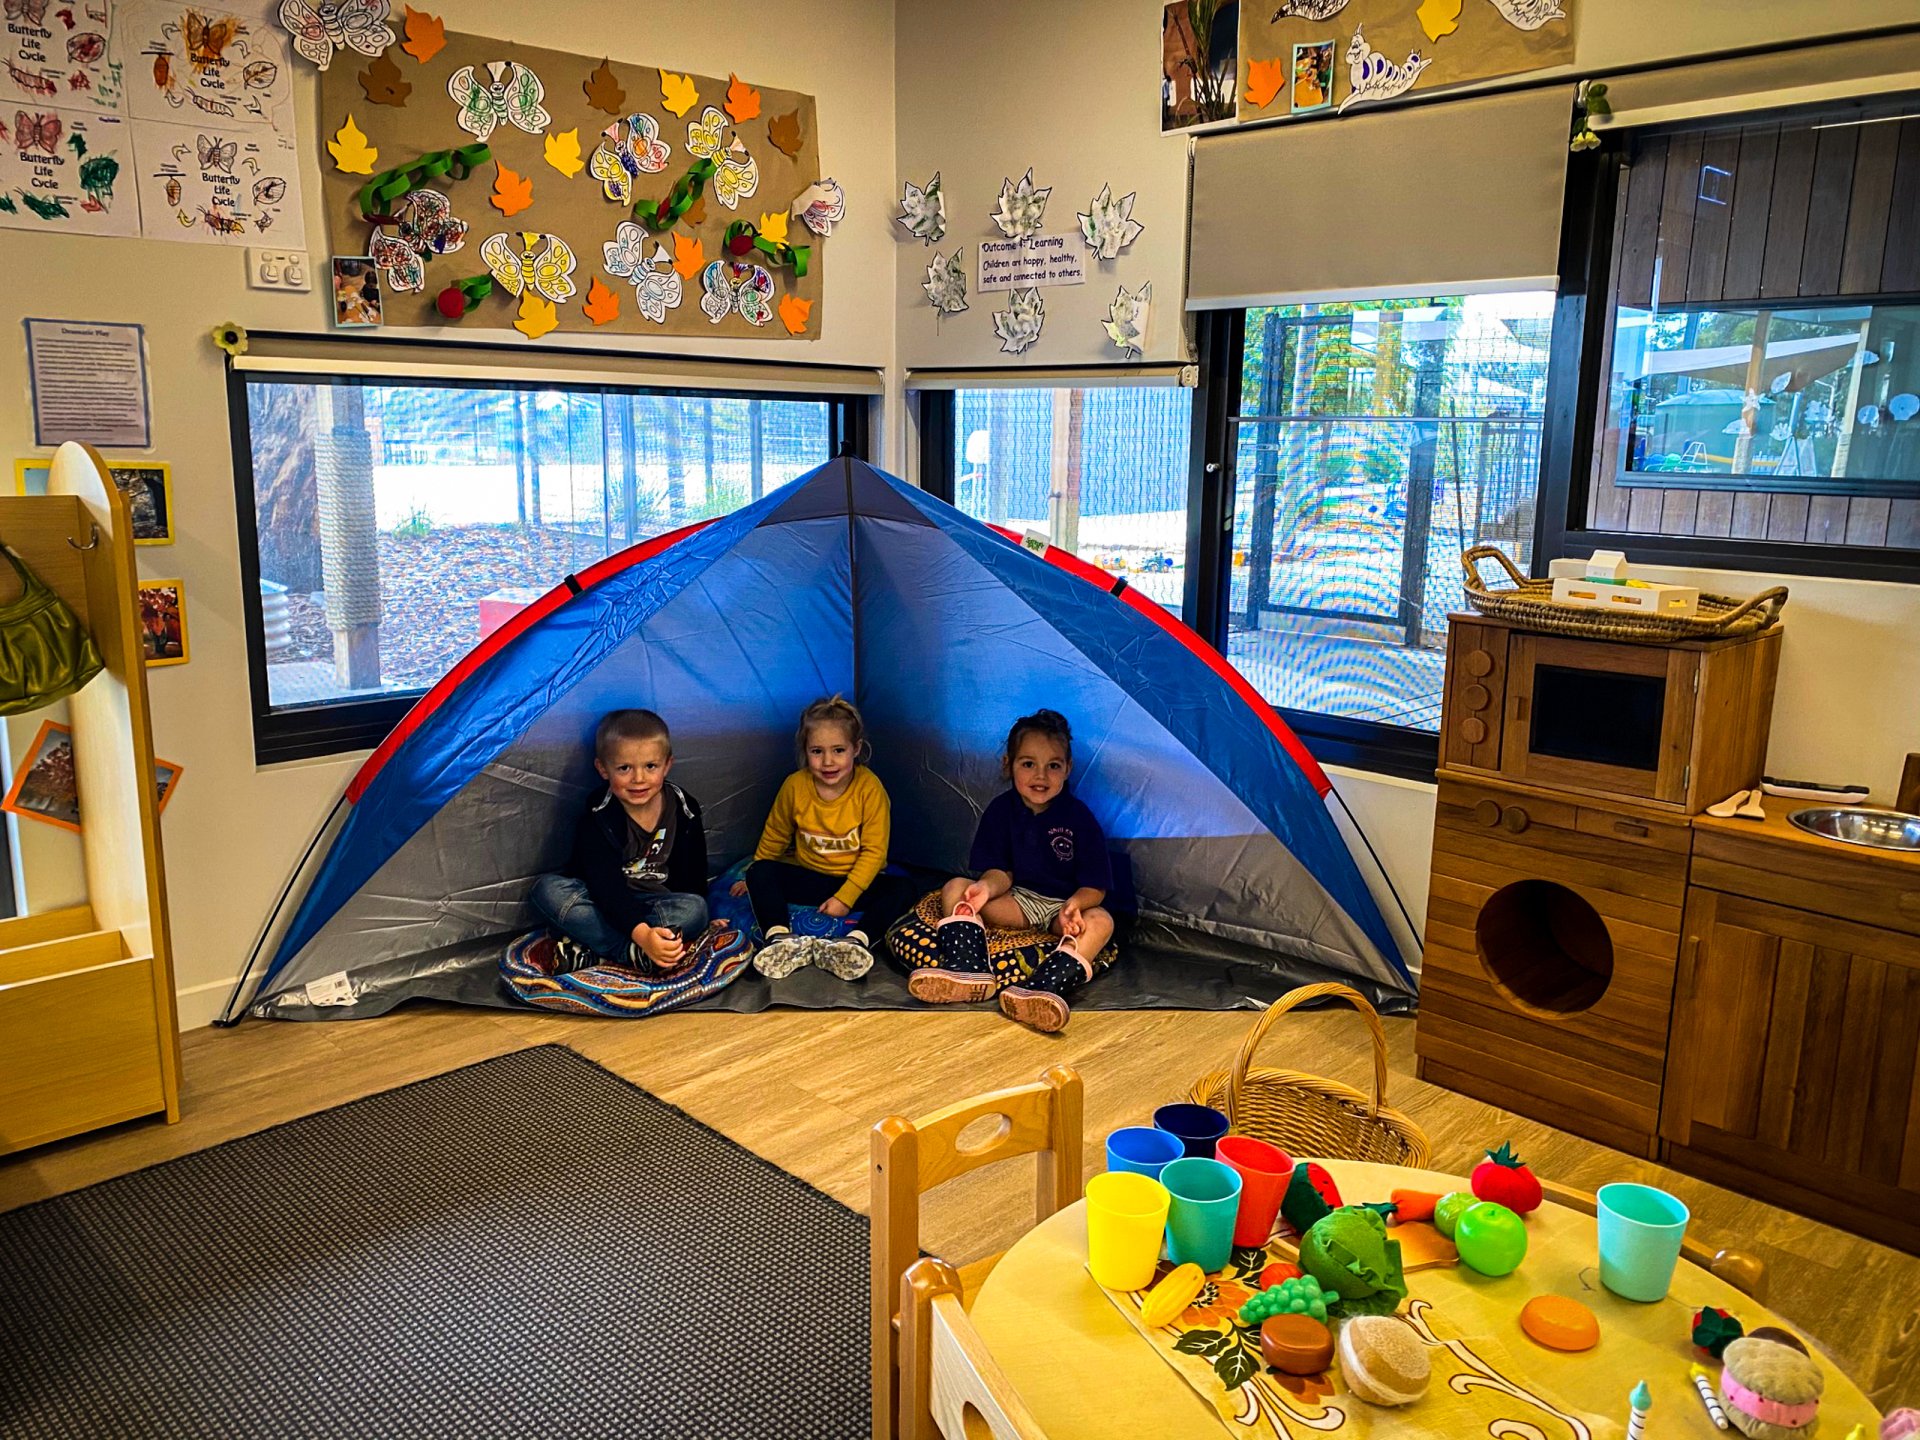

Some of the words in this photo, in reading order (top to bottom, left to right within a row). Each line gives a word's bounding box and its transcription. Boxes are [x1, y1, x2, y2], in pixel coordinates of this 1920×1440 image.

[8, 23, 52, 39] Butterfly
[22, 38, 41, 50] Life
[18, 50, 46, 62] Cycle
[191, 53, 230, 67] Butterfly
[203, 67, 220, 77] Life
[200, 78, 225, 89] Cycle
[20, 152, 65, 165] Butterfly
[34, 166, 53, 177] Life
[31, 178, 58, 189] Cycle
[202, 172, 240, 185] Butterfly
[214, 185, 231, 196] Life
[212, 196, 235, 207] Cycle
[982, 242, 1016, 252] Outcome
[1029, 236, 1064, 250] Learning
[983, 259, 1010, 271] Children
[1023, 256, 1046, 267] happy,
[1050, 254, 1077, 264] healthy,
[983, 275, 997, 283] safe
[1000, 273, 1012, 281] and
[1014, 271, 1046, 281] connected
